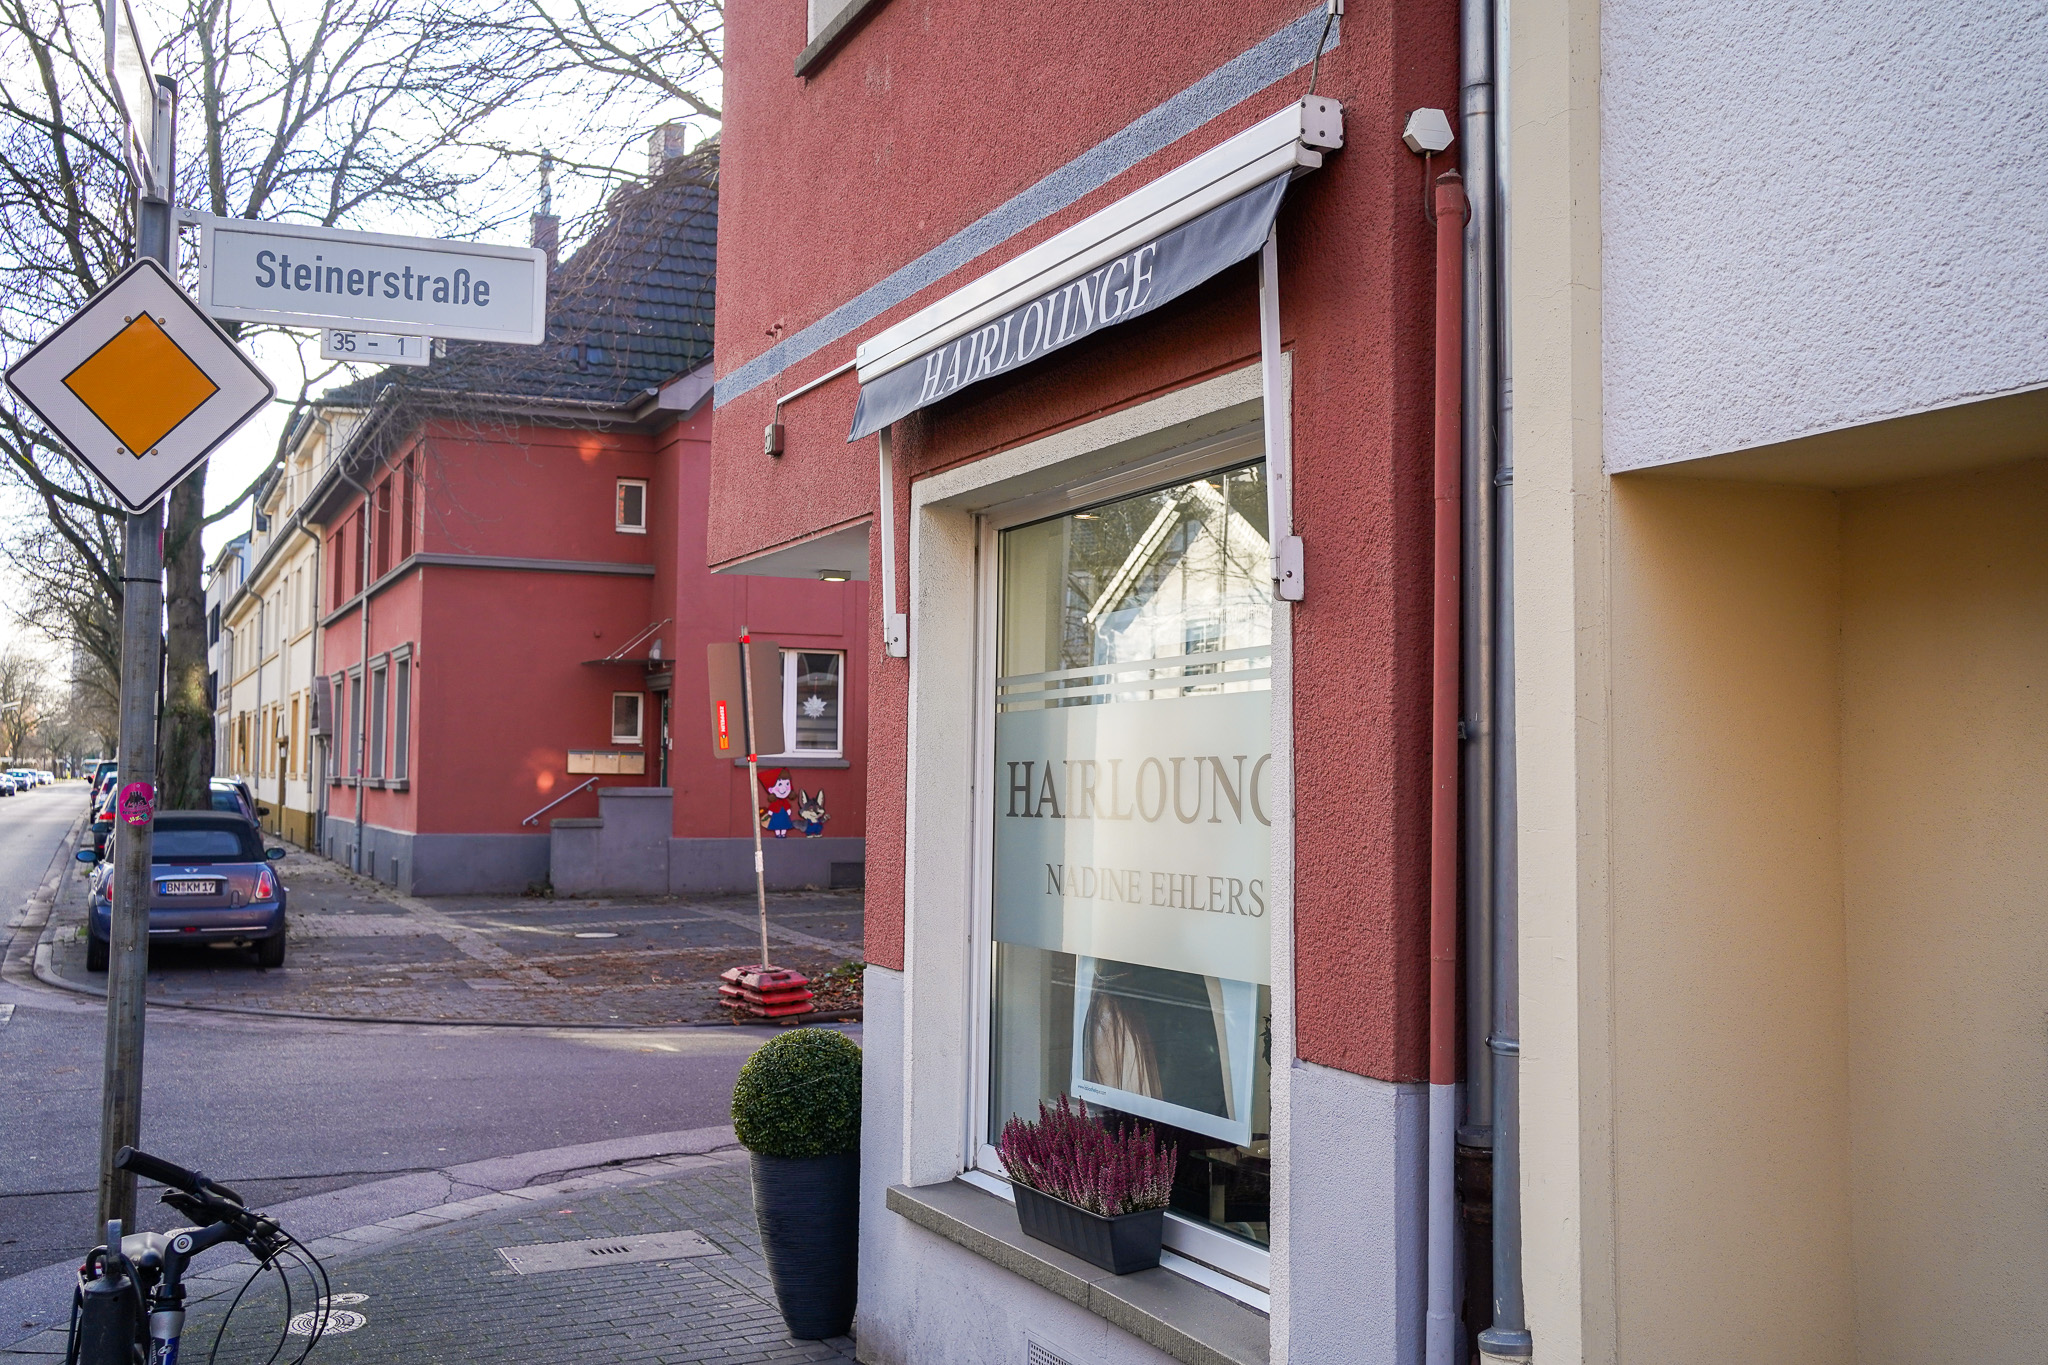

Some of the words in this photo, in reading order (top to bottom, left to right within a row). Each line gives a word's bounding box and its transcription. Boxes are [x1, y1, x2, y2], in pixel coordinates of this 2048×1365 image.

[255, 250, 491, 307] Steinerstraße
[333, 332, 357, 352] 35
[397, 337, 405, 356] 1
[914, 241, 1157, 407] HAIRLOUNGE
[167, 882, 181, 892] BN
[187, 882, 200, 892] KM
[202, 882, 215, 892] 17
[1045, 863, 1142, 905] NADINE
[1149, 871, 1265, 918] EHLERS
